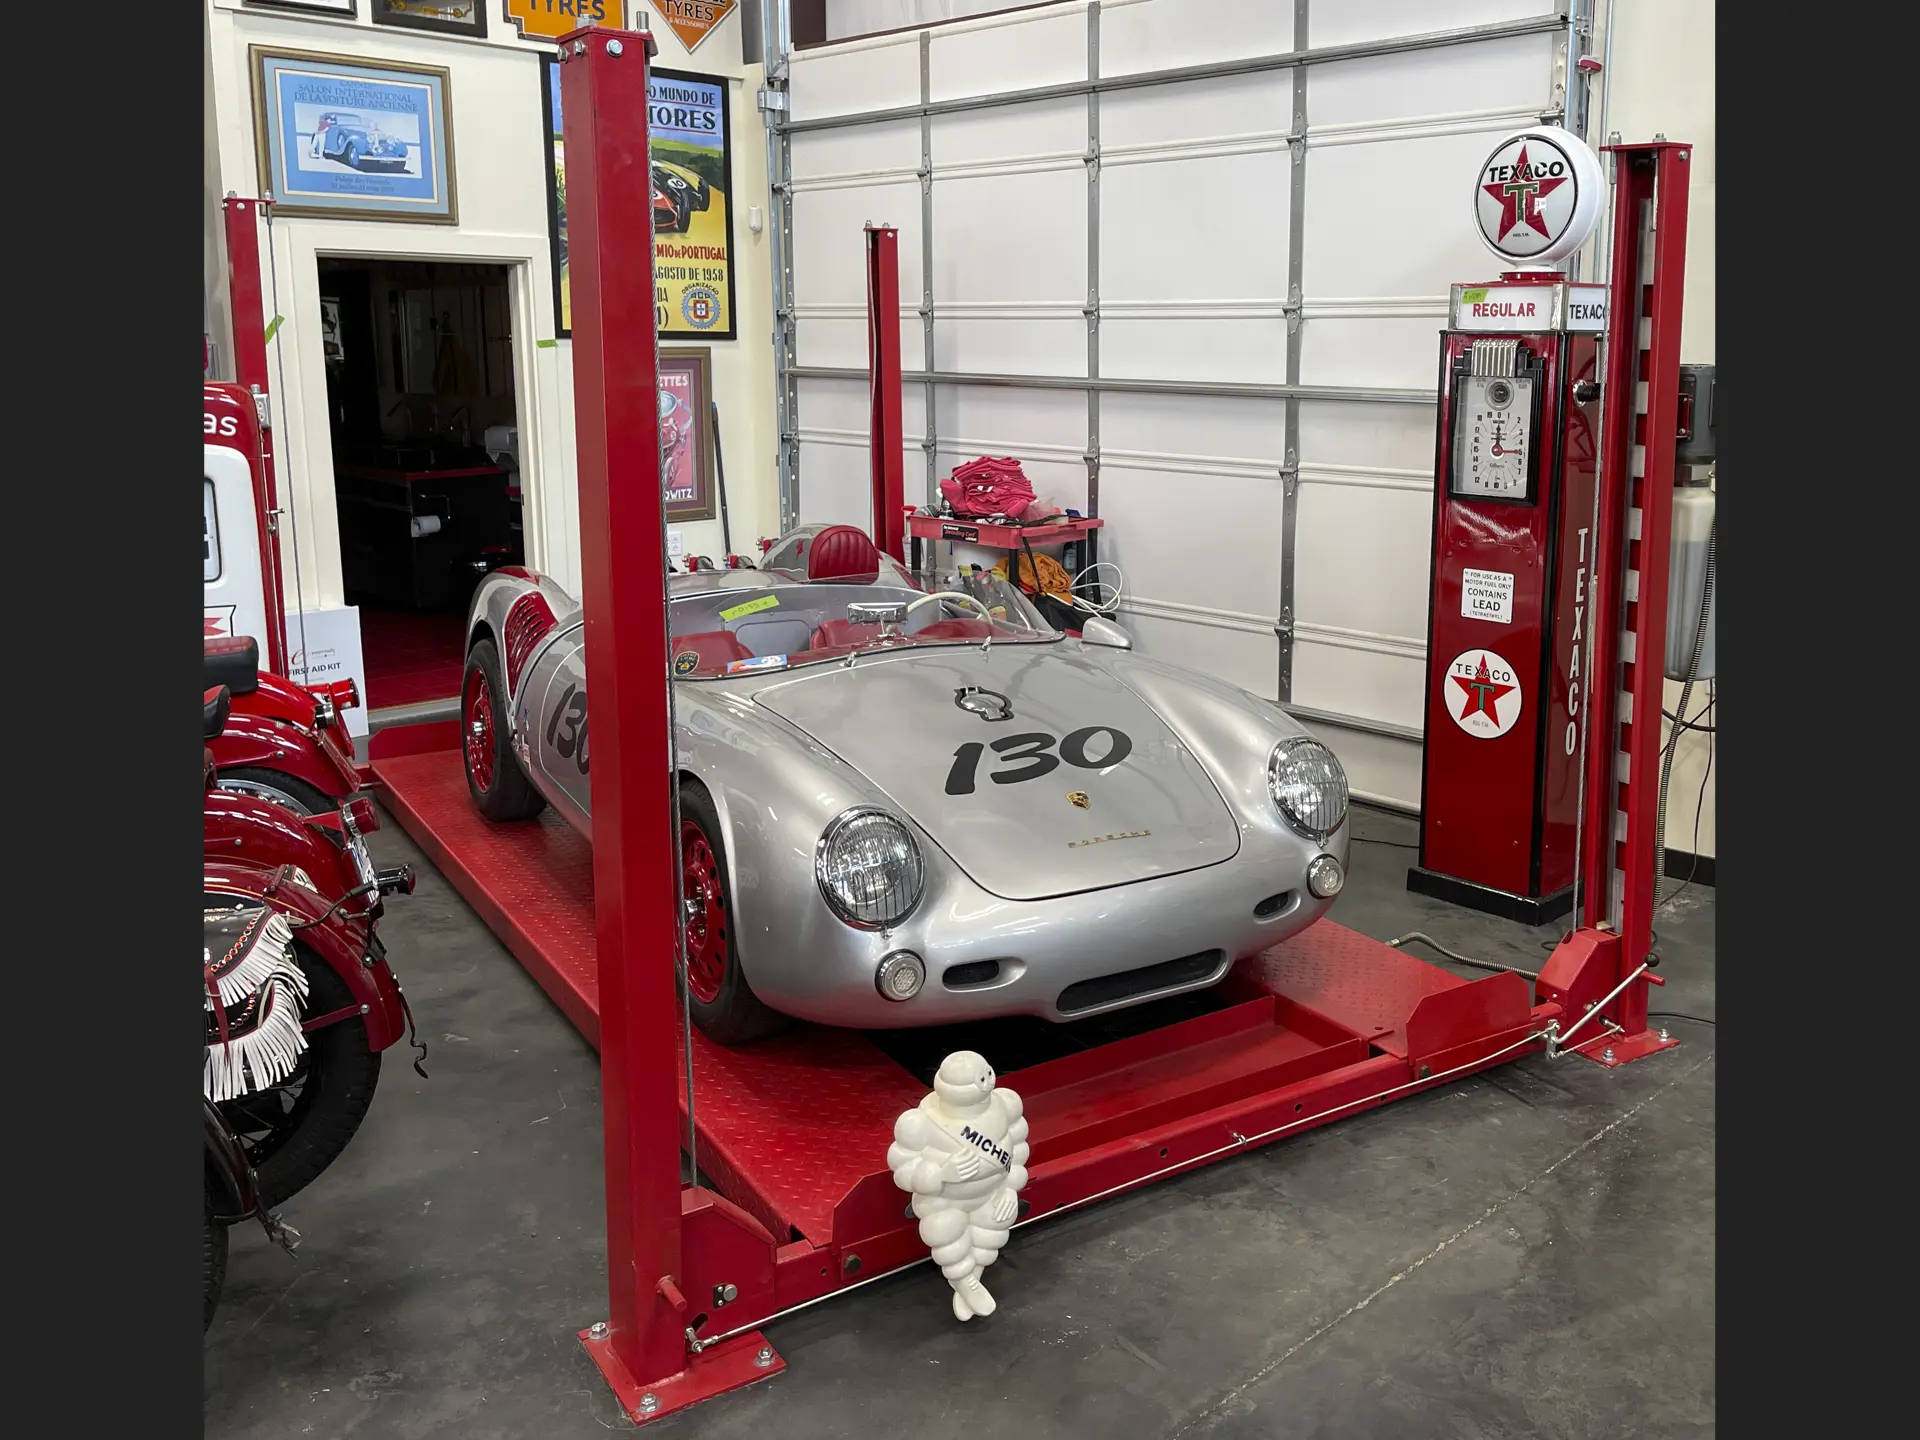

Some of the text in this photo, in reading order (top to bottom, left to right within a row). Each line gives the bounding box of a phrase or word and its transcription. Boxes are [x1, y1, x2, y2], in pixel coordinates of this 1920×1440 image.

[663, 0, 714, 21] TYRES
[294, 92, 418, 112] DE LA VOITURE ANCIENNE
[299, 84, 411, 103] SALON INTERNATIONAL
[660, 86, 698, 103] MUNDO
[702, 91, 716, 105] DE
[649, 105, 716, 130] TORES
[1489, 161, 1564, 182] TEXACO
[1503, 182, 1540, 223] T
[656, 244, 674, 258] MIO
[681, 245, 727, 260] PORTUGAL
[689, 267, 700, 281] DE
[702, 268, 724, 282] 1958
[1472, 302, 1536, 318] REGULAR
[204, 412, 238, 437] as
[1465, 578, 1483, 586] MOTOR
[1467, 587, 1508, 600] CONTAINS
[1472, 598, 1501, 612] LEAD
[1565, 528, 1589, 756] TEXACO
[311, 665, 327, 673] AID
[327, 662, 341, 671] KIT
[1456, 662, 1511, 682] TEXACO
[1470, 682, 1496, 711] T
[944, 726, 1133, 796] 130
